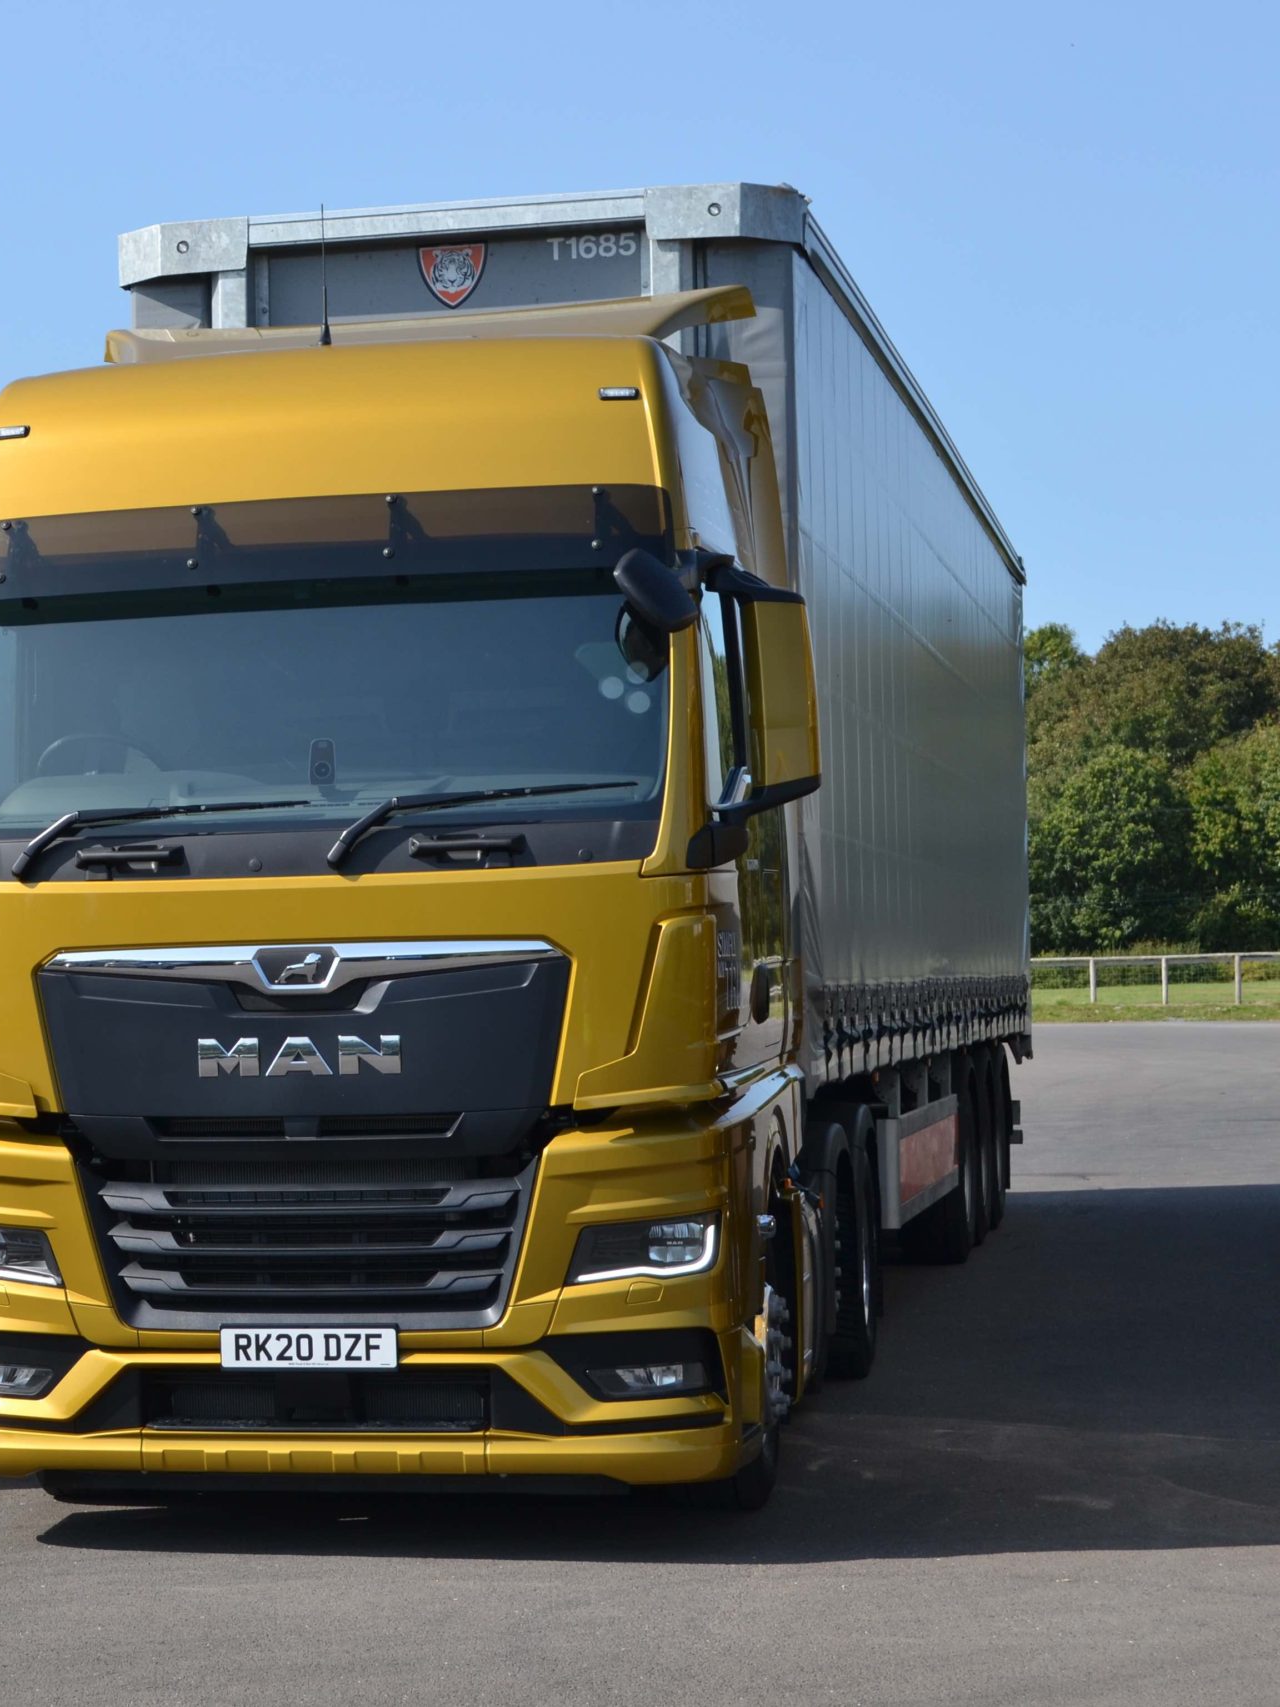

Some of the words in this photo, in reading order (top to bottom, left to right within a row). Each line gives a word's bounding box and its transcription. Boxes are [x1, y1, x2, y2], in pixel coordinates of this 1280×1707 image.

[546, 232, 637, 261] T1685
[197, 1034, 401, 1077] MAN
[234, 1333, 314, 1361] RK20
[323, 1333, 383, 1361] DZF
